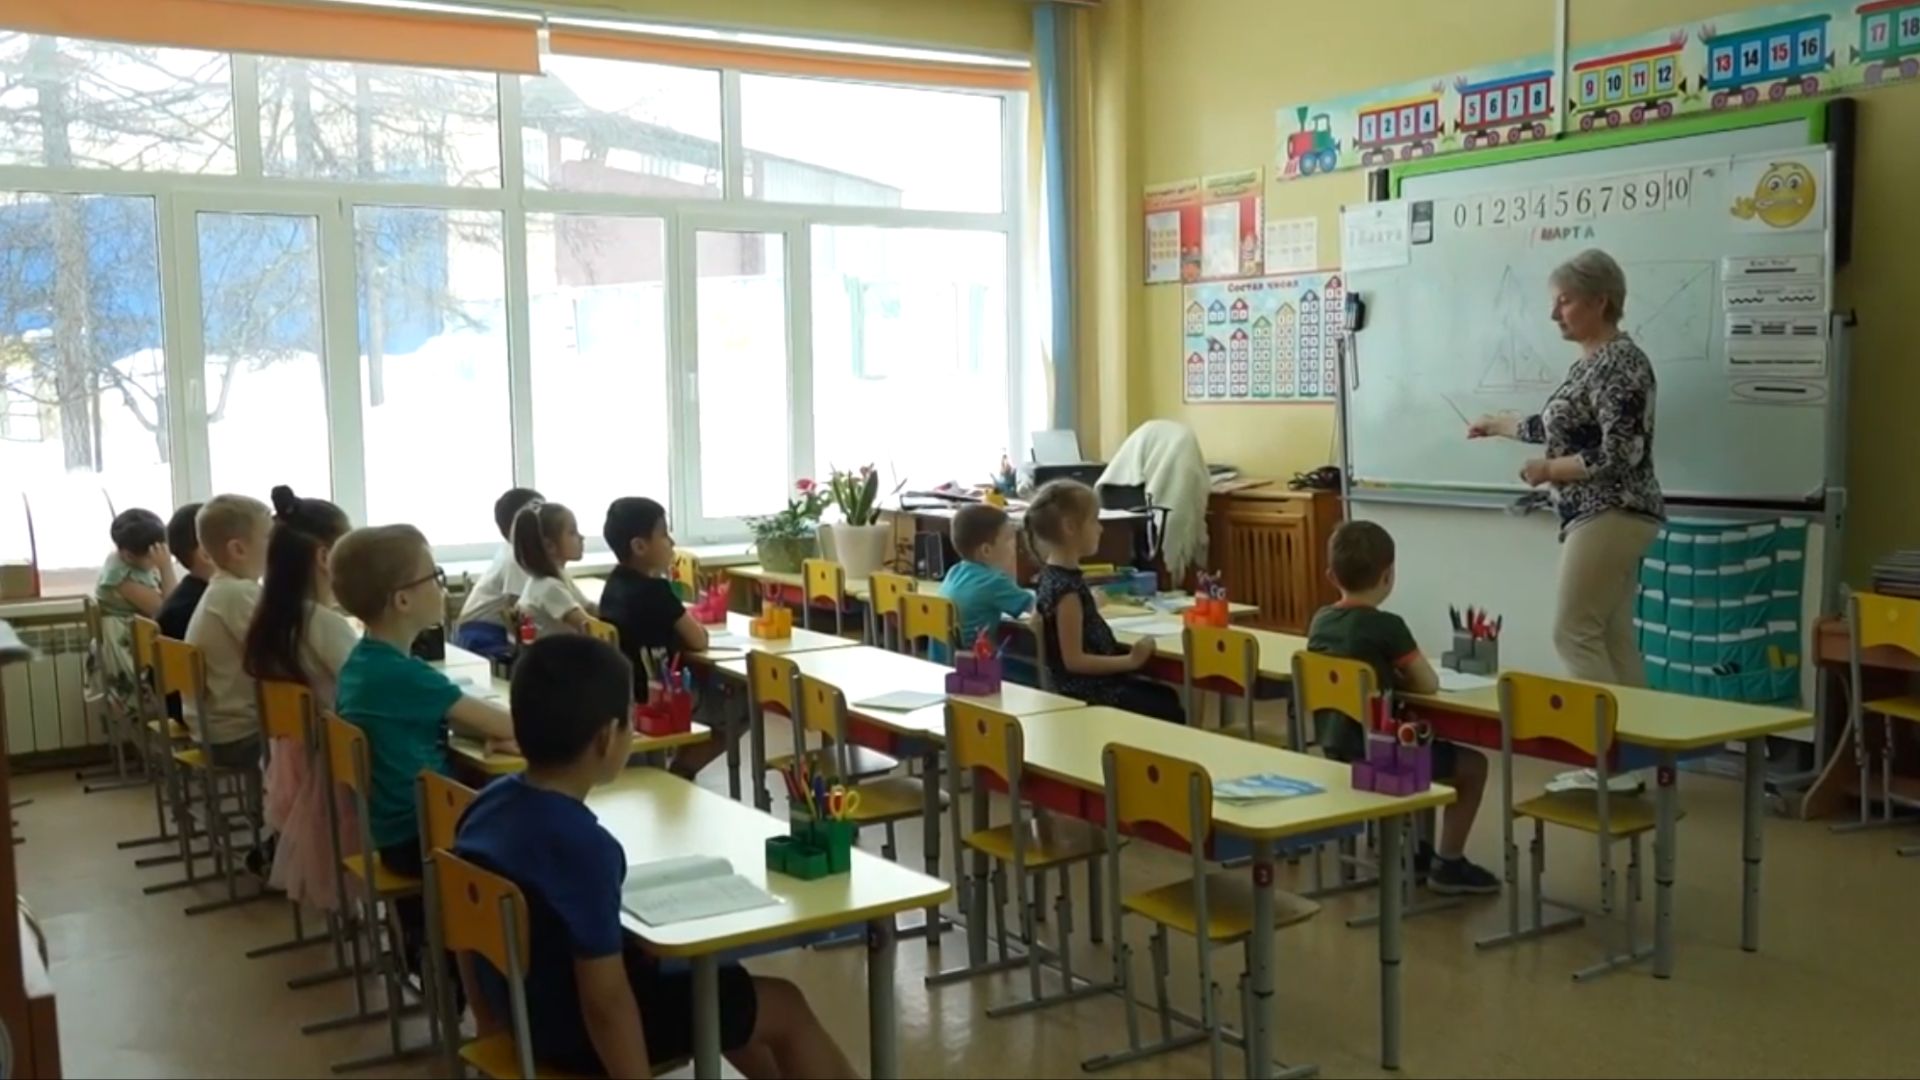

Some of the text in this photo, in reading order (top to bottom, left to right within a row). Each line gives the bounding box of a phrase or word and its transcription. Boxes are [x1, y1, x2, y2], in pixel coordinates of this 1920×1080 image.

[1870, 18, 1920, 42] 17 18
[1715, 37, 1818, 72] 13 14 15 16
[1585, 65, 1672, 97] 9 10 11 12
[1468, 90, 1542, 117] 5 6 7 8
[1366, 111, 1431, 135] 1 2 3 4
[1454, 176, 1689, 228] 0 1 2 3 4 5 6 7 8 9 10
